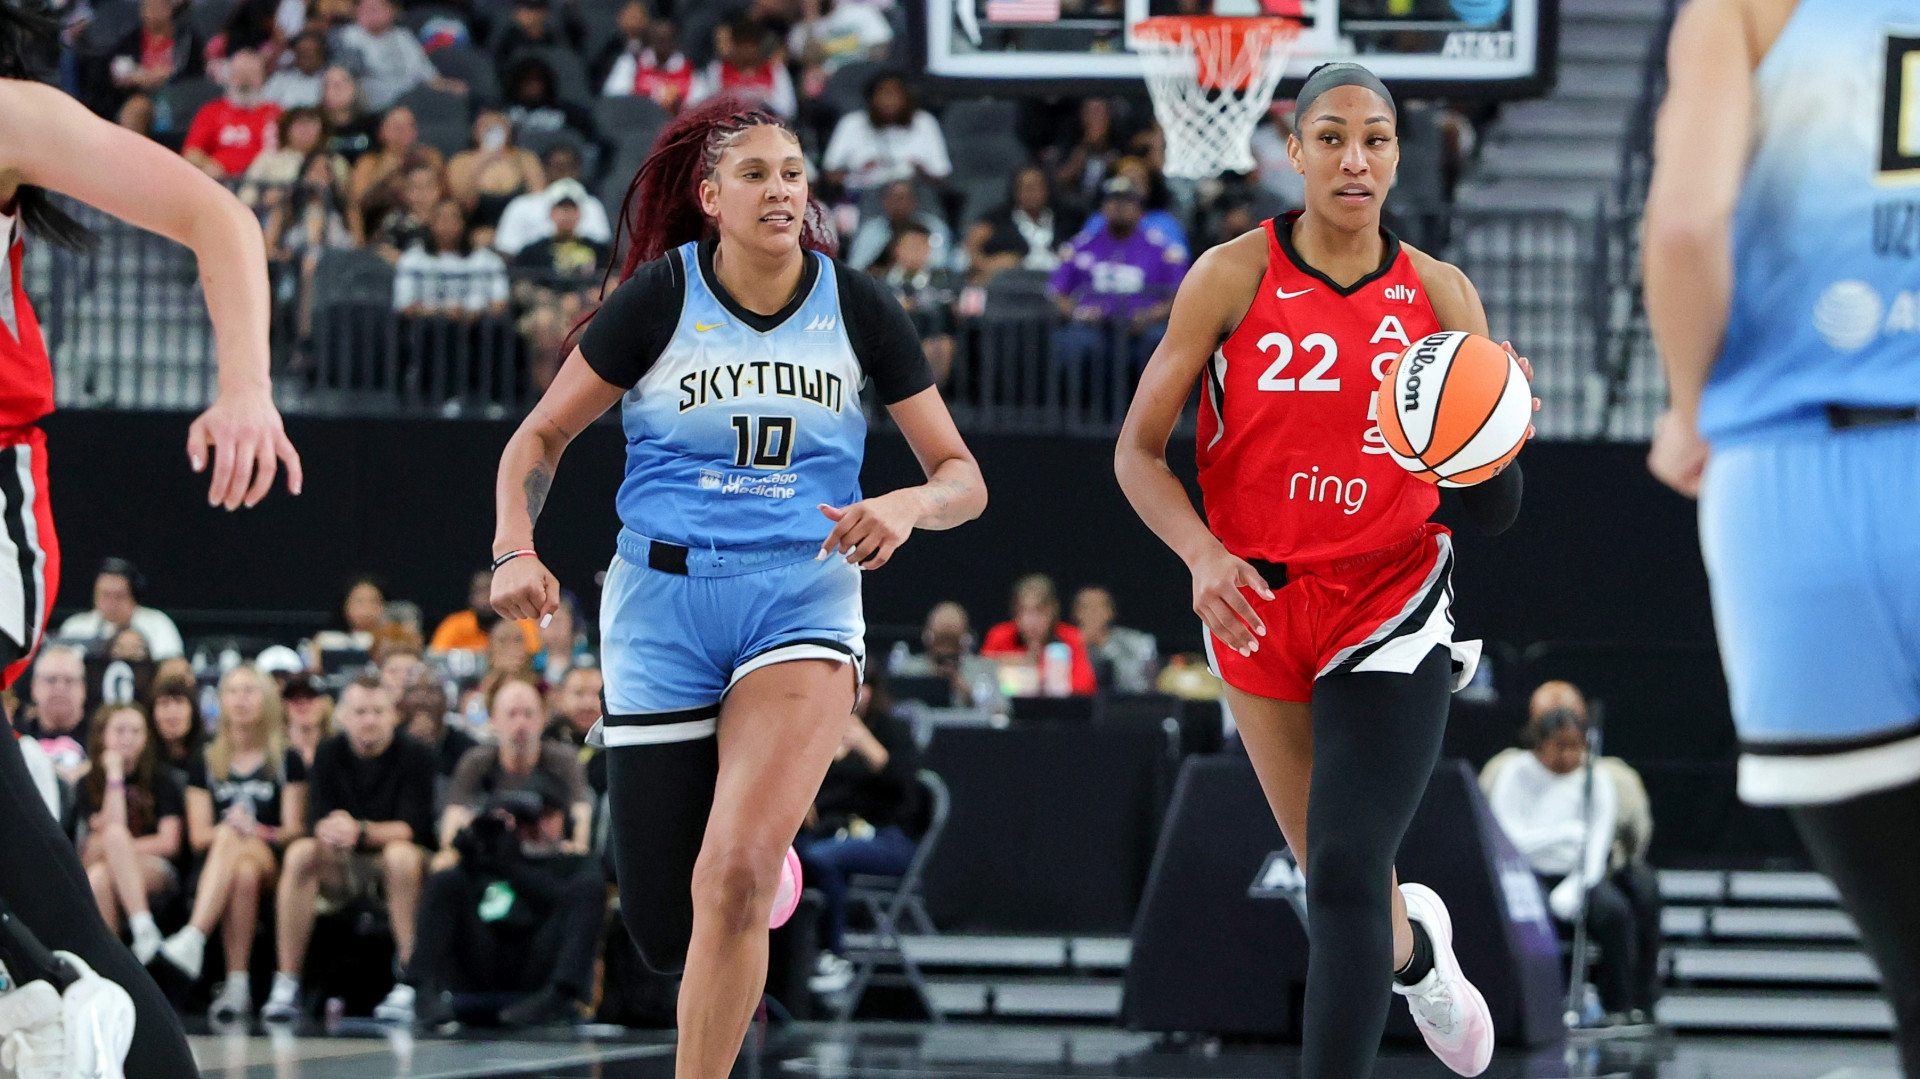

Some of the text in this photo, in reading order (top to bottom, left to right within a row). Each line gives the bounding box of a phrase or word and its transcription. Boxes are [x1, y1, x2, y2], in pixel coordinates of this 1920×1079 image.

[1441, 31, 1514, 60] AT&T
[1873, 202, 1920, 260] UZ
[1384, 284, 1417, 304] ally
[1885, 290, 1920, 334] A
[1256, 332, 1341, 392] 22
[1404, 331, 1454, 413] Wilson
[730, 414, 797, 470] 10
[1289, 465, 1368, 515] ring
